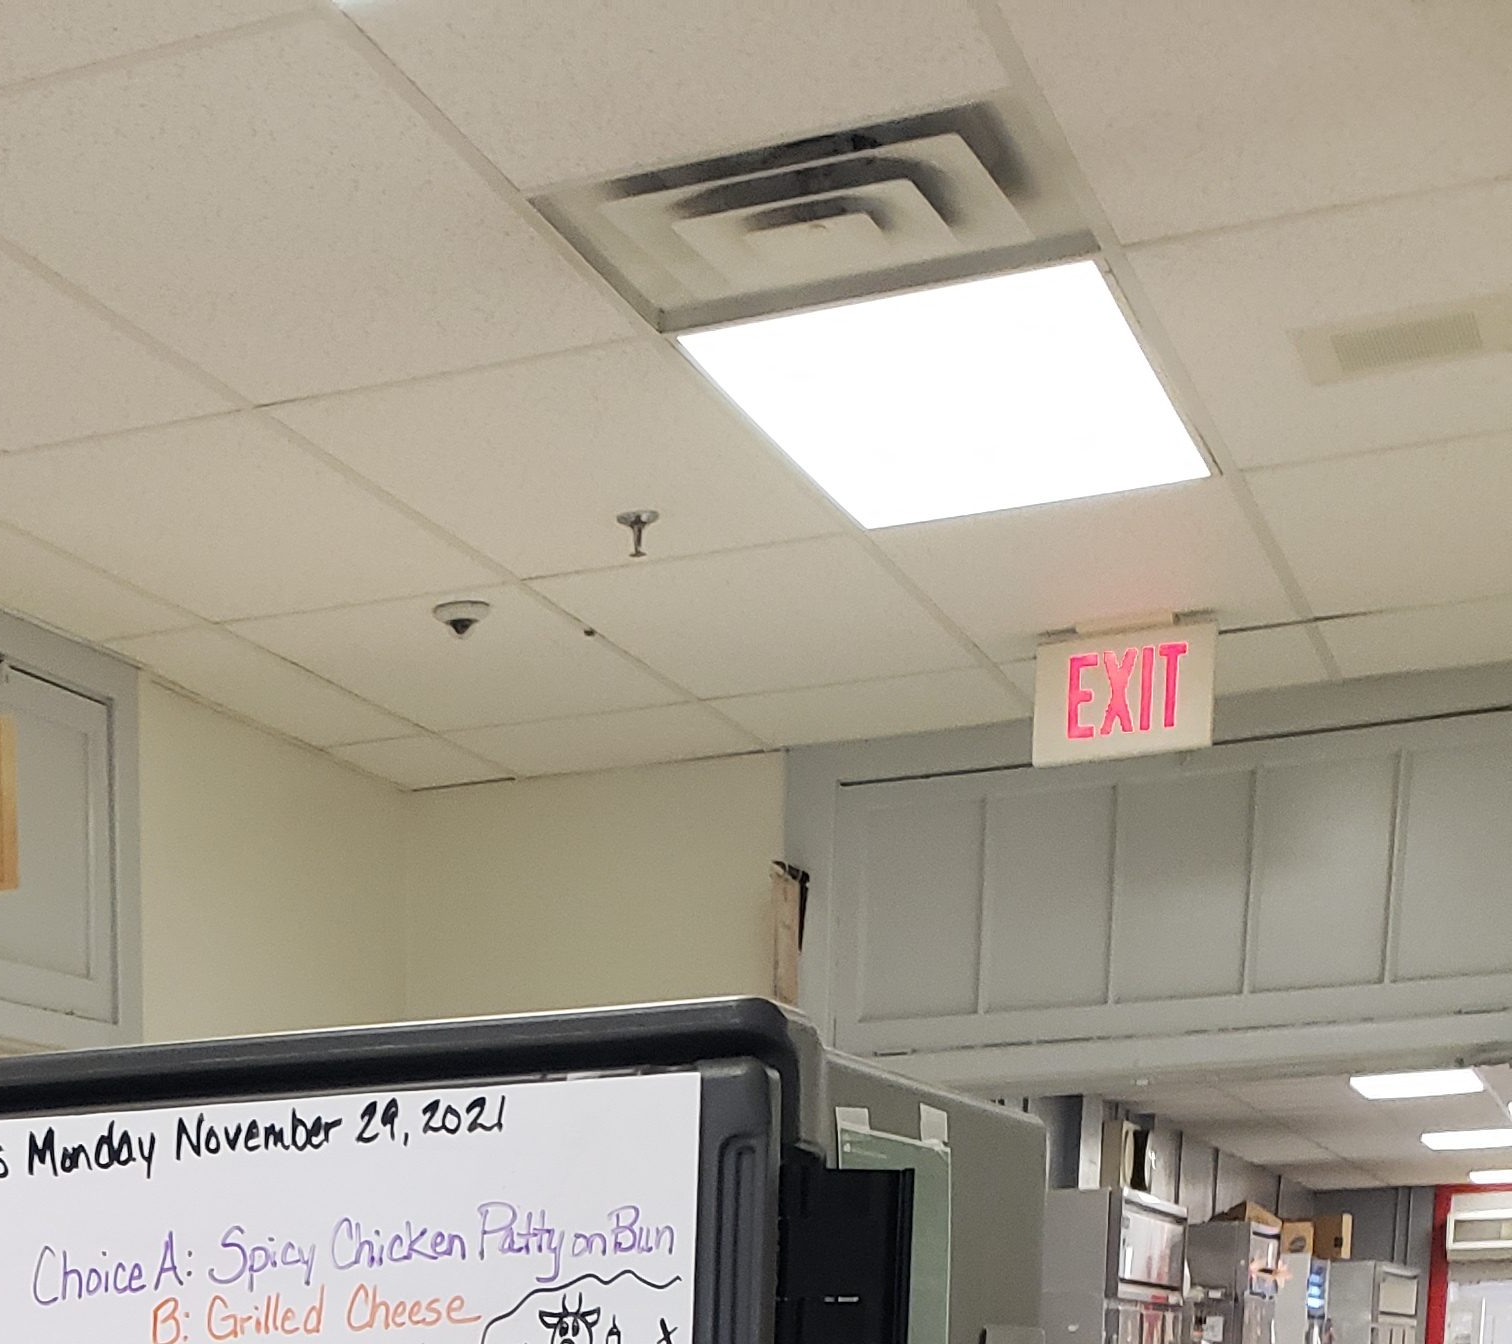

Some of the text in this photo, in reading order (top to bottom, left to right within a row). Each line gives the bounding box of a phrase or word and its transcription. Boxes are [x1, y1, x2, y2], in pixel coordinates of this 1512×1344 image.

[1067, 641, 1189, 740] EXIT
[28, 1120, 156, 1179] Monday
[176, 1108, 342, 1160] November
[356, 1097, 409, 1146] 29,
[422, 1095, 505, 1133] 2021
[33, 1244, 147, 1306] Choice
[154, 1230, 193, 1291] A:
[208, 1225, 316, 1292] Spicy
[331, 1217, 467, 1270] Chicken
[477, 1201, 565, 1283] Patty
[571, 1232, 607, 1257] on
[608, 1205, 675, 1255] Bun
[207, 1283, 326, 1340] Grilled
[347, 1283, 482, 1331] Cheese
